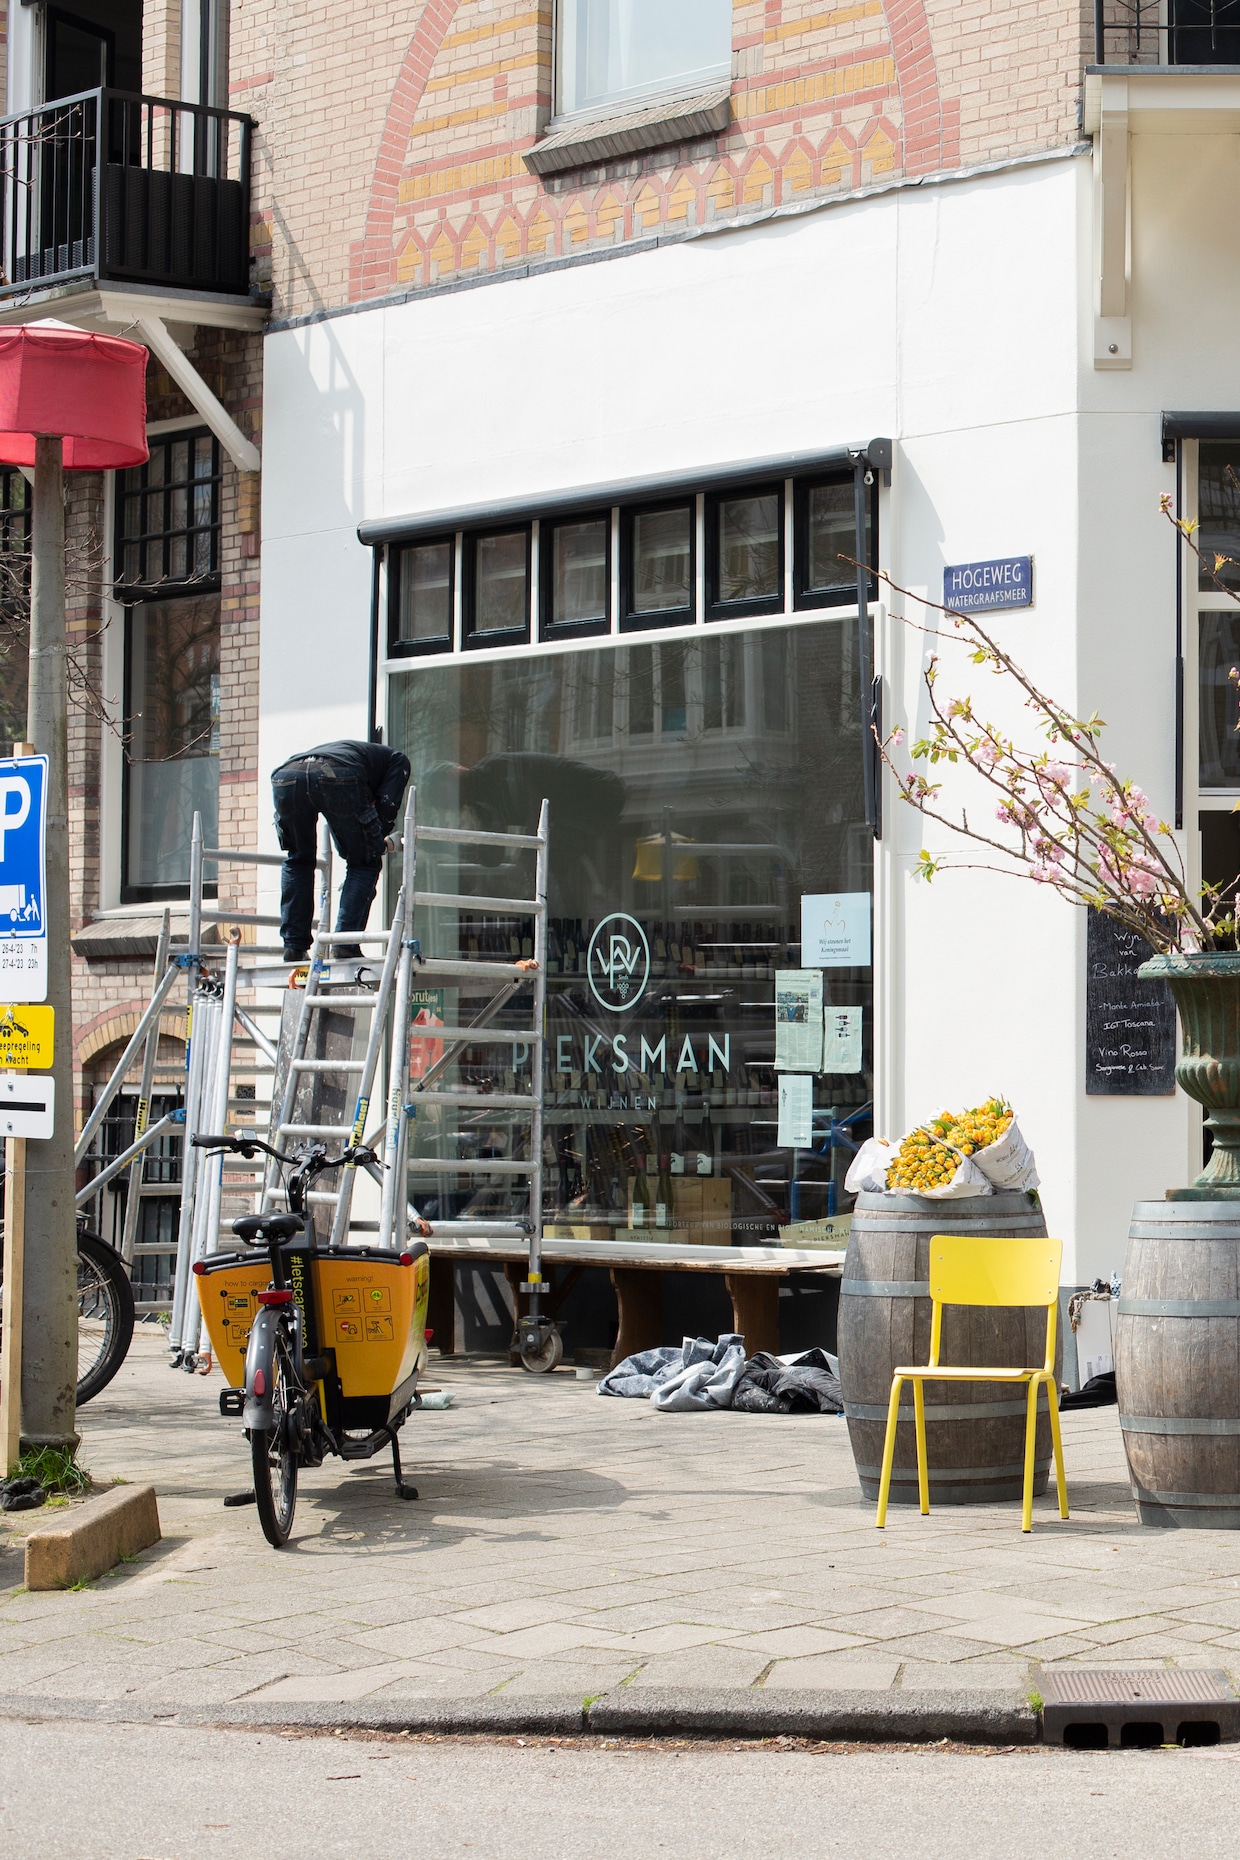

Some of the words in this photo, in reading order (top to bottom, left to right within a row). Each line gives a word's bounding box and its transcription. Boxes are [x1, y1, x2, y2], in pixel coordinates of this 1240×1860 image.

[952, 563, 1021, 590] HOGEWEG
[947, 588, 1027, 608] WATERGRAAFSMEER
[0, 776, 31, 862] P
[28, 959, 38, 969] 23h
[1103, 1021, 1121, 1030] IGT
[1121, 1019, 1155, 1028] Toscana
[512, 1033, 730, 1073] PEKSMAN
[1099, 1047, 1118, 1057] Vino
[1120, 1044, 1147, 1057] Rosso
[580, 1095, 657, 1110] WIJNEN
[352, 1098, 368, 1148] urMaat
[717, 1222, 763, 1230] BIOLOGISCHE
[813, 1231, 850, 1242] PIEKSMAN
[346, 1275, 374, 1283] warning!
